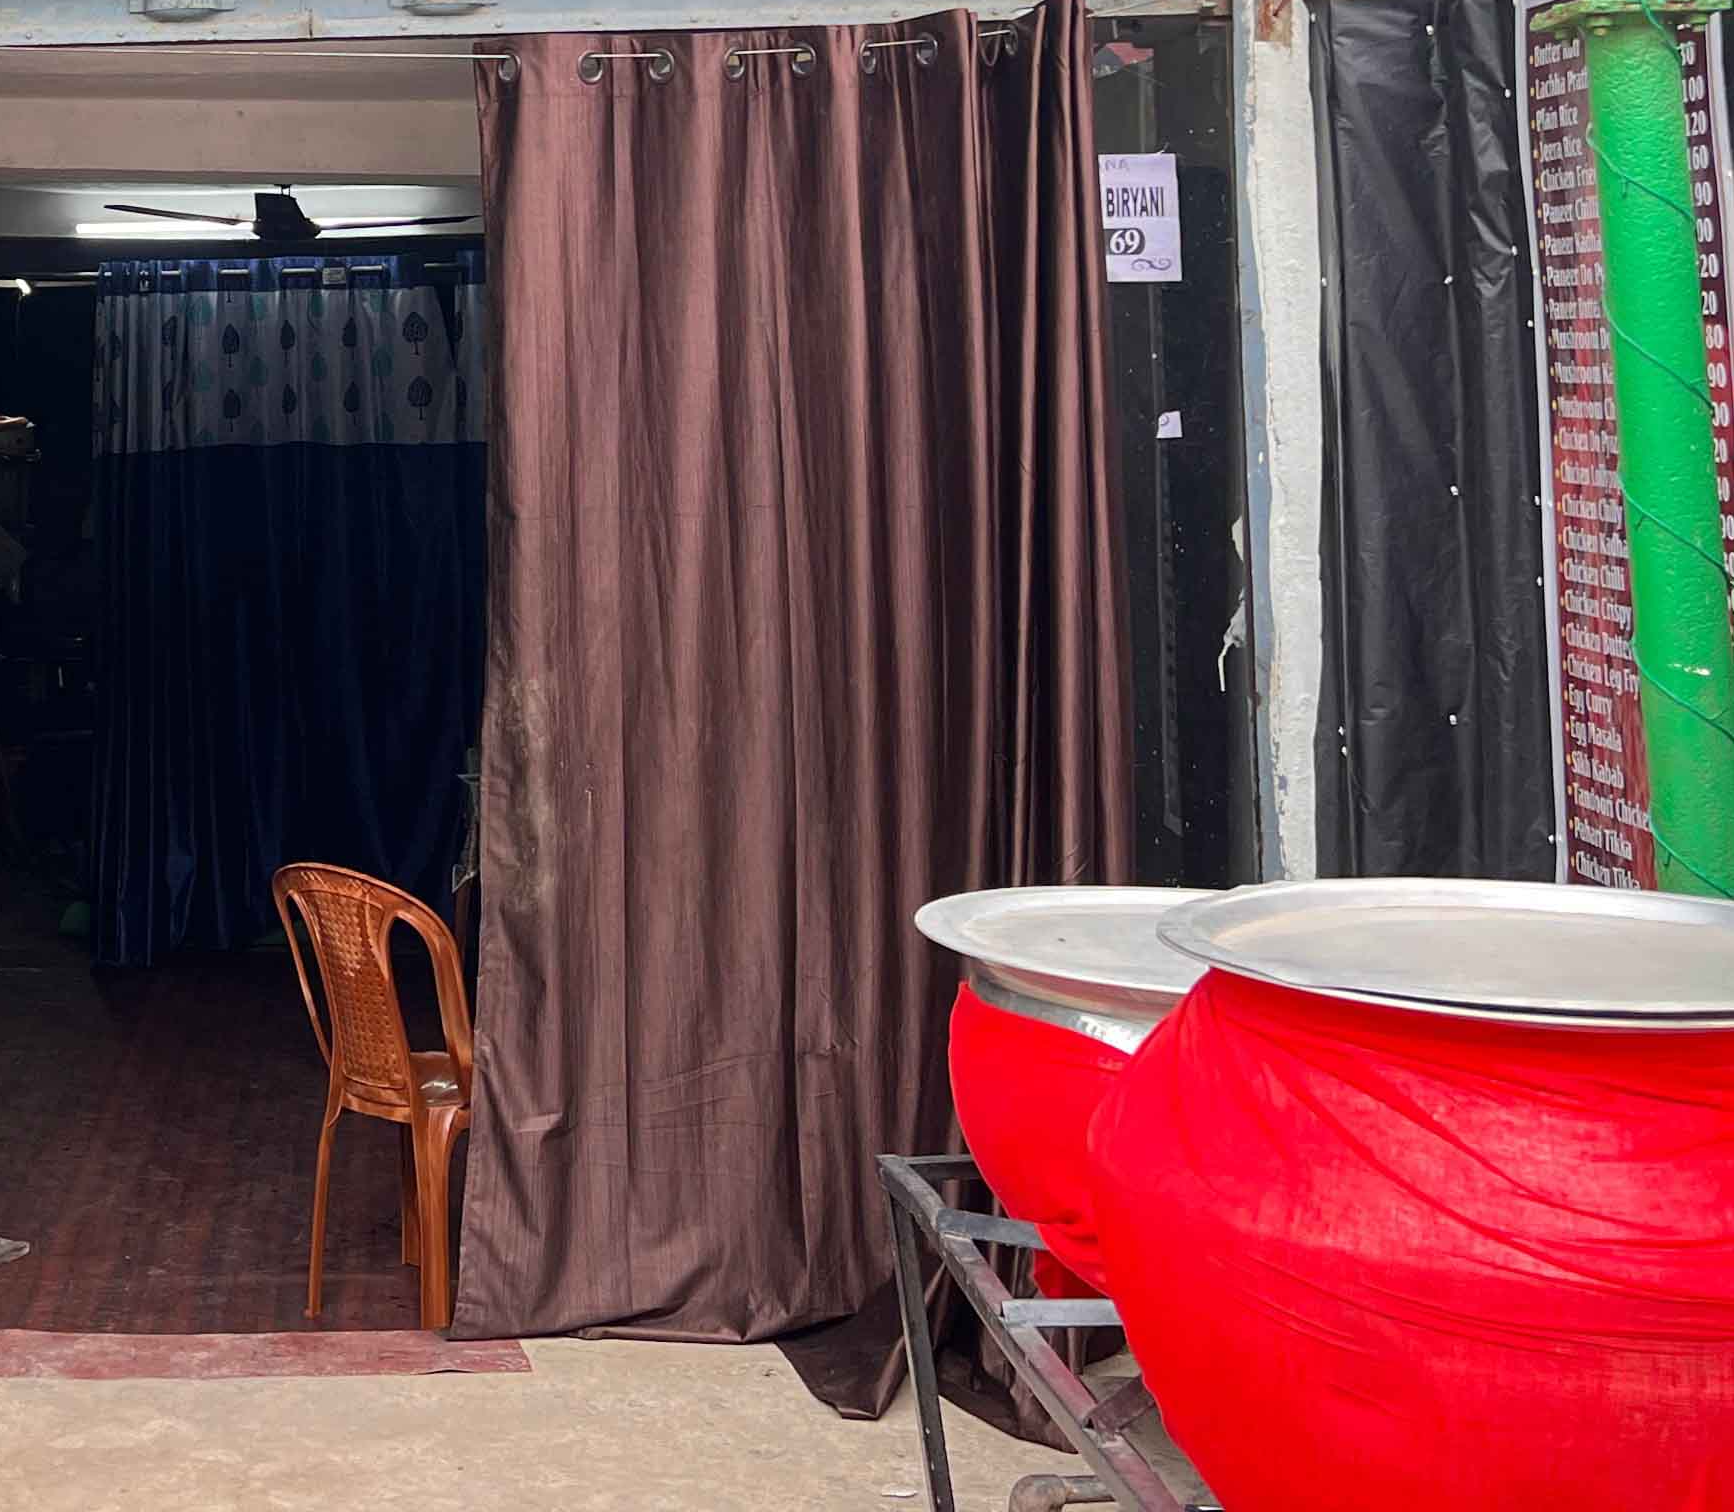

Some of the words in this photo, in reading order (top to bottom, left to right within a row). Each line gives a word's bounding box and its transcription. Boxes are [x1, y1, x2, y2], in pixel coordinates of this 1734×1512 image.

[1540, 167, 1575, 192] Chicken
[1106, 186, 1165, 218] BIRYANI
[1109, 229, 1141, 254] 69
